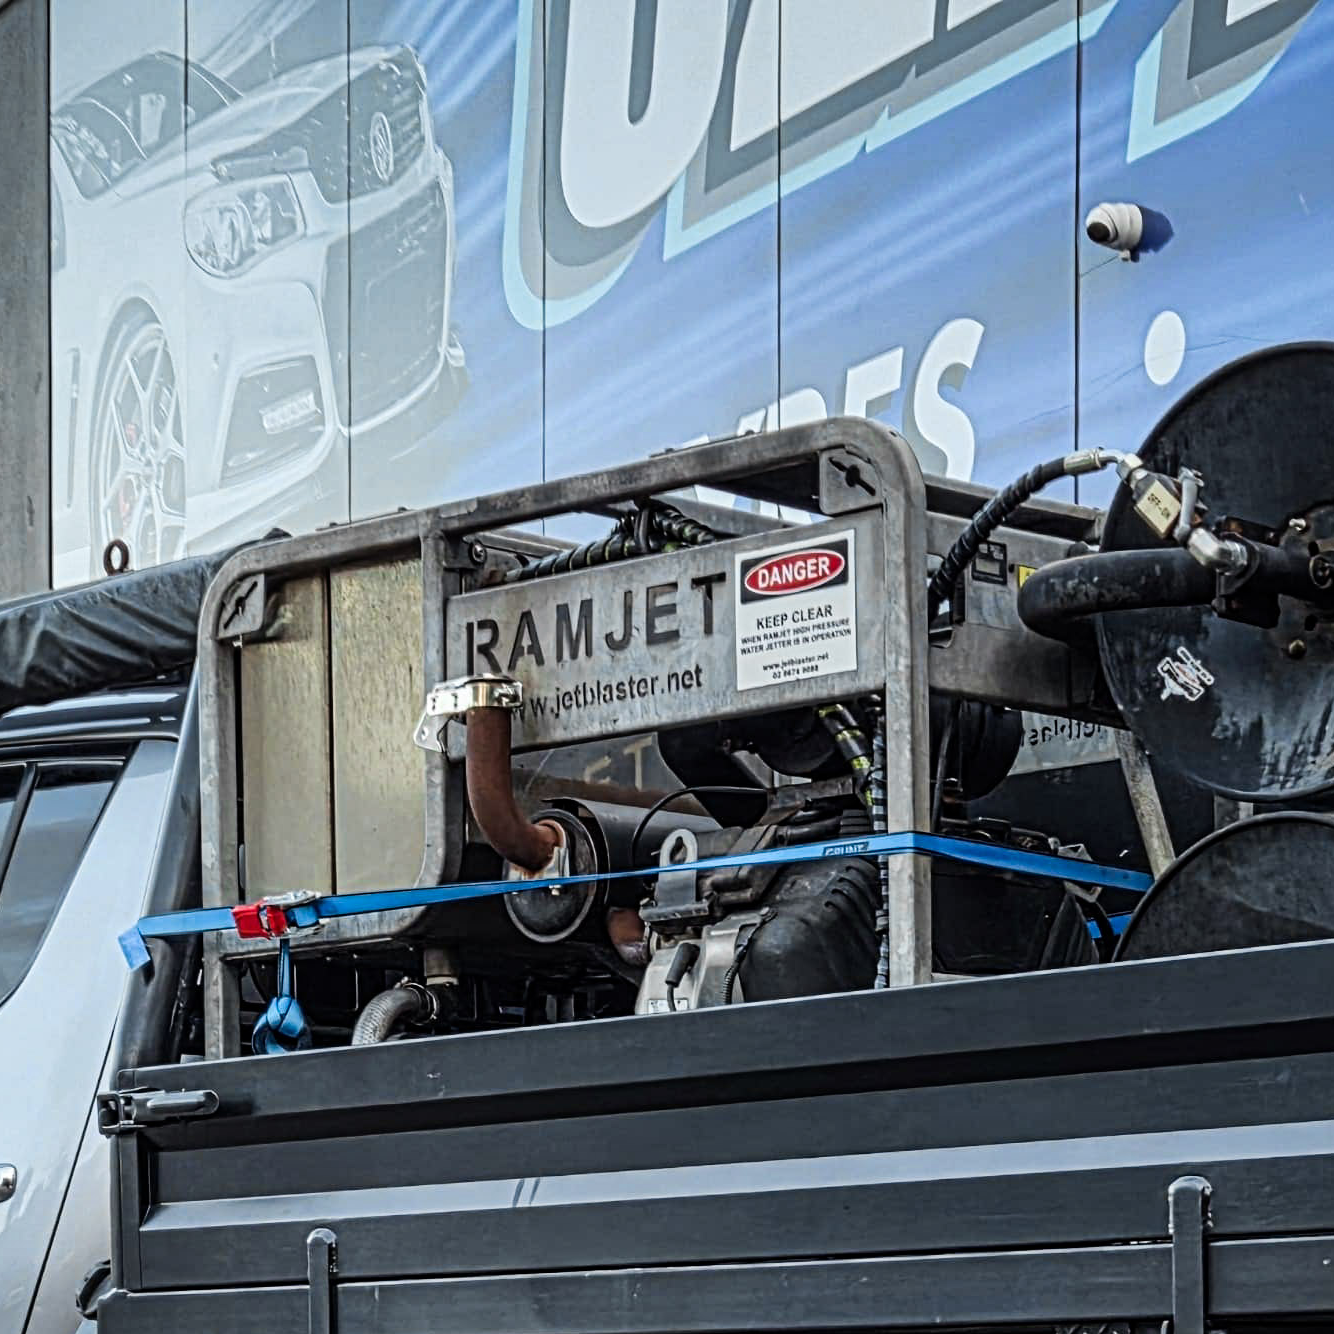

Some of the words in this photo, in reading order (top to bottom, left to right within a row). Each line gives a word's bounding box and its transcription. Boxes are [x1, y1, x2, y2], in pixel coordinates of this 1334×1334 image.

[758, 556, 830, 588] DANGER
[466, 572, 726, 676] RAMJET
[756, 613, 788, 630] KEEP
[792, 604, 833, 624] CLEAR
[741, 635, 762, 645] WHEN
[763, 631, 791, 642] RAMJET
[812, 618, 850, 632] PRESSURE
[741, 645, 763, 655] WATER
[765, 639, 792, 651] JETTER
[811, 629, 852, 642] OPERATION
